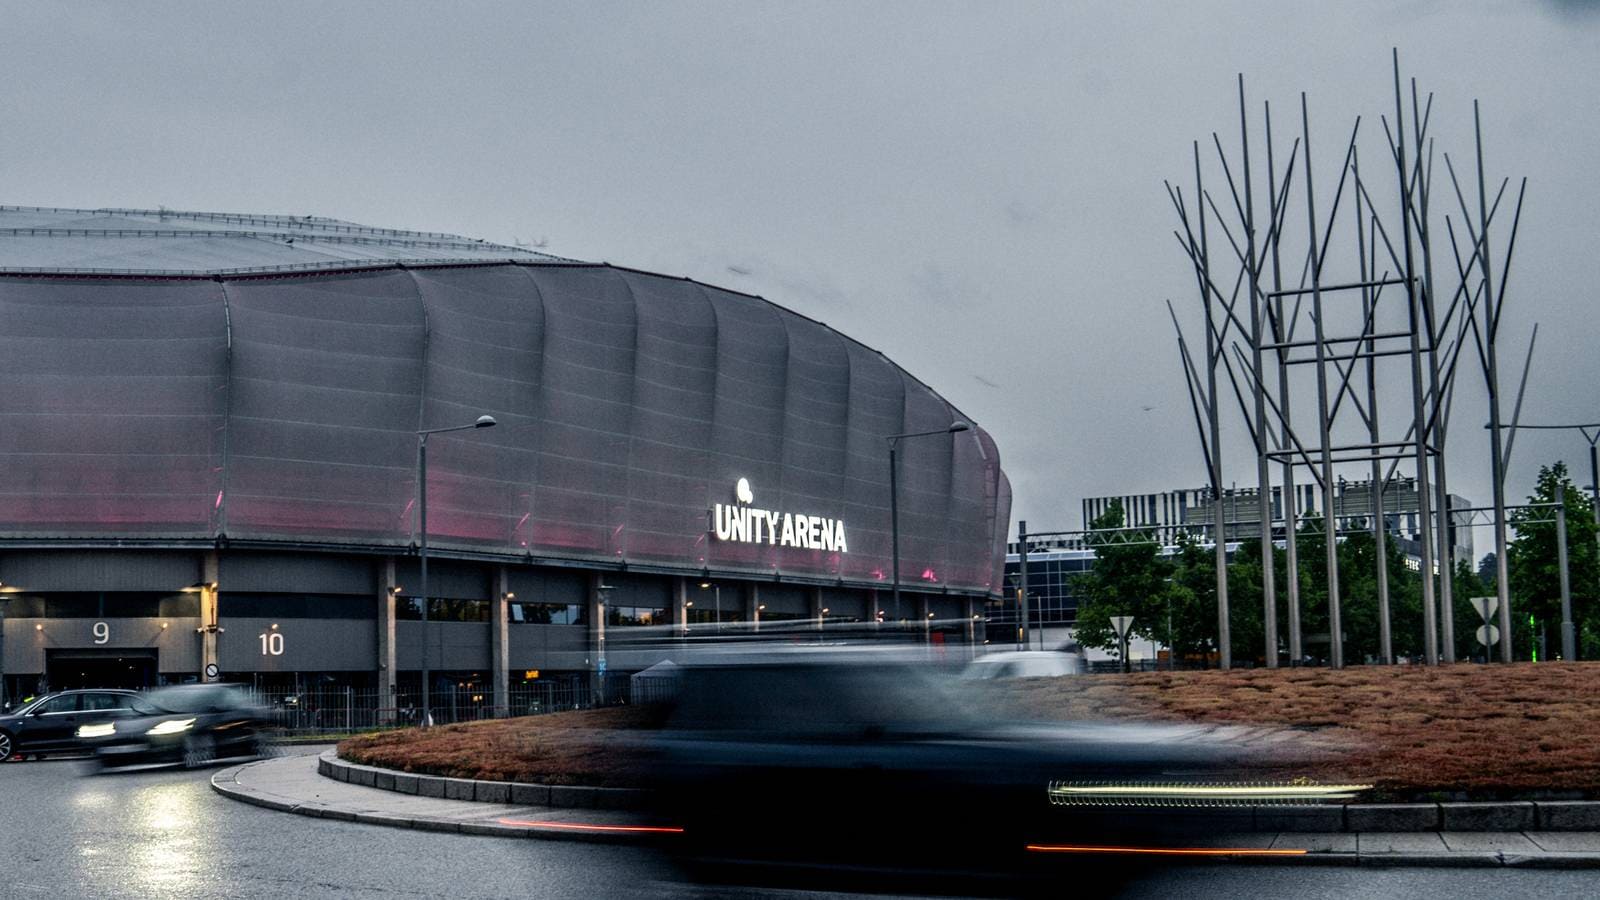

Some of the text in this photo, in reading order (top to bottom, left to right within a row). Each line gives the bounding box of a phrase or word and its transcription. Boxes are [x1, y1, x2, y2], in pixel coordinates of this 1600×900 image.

[715, 503, 848, 553] UNITY ARENA
[92, 621, 110, 645] 9
[258, 632, 285, 656] 10
